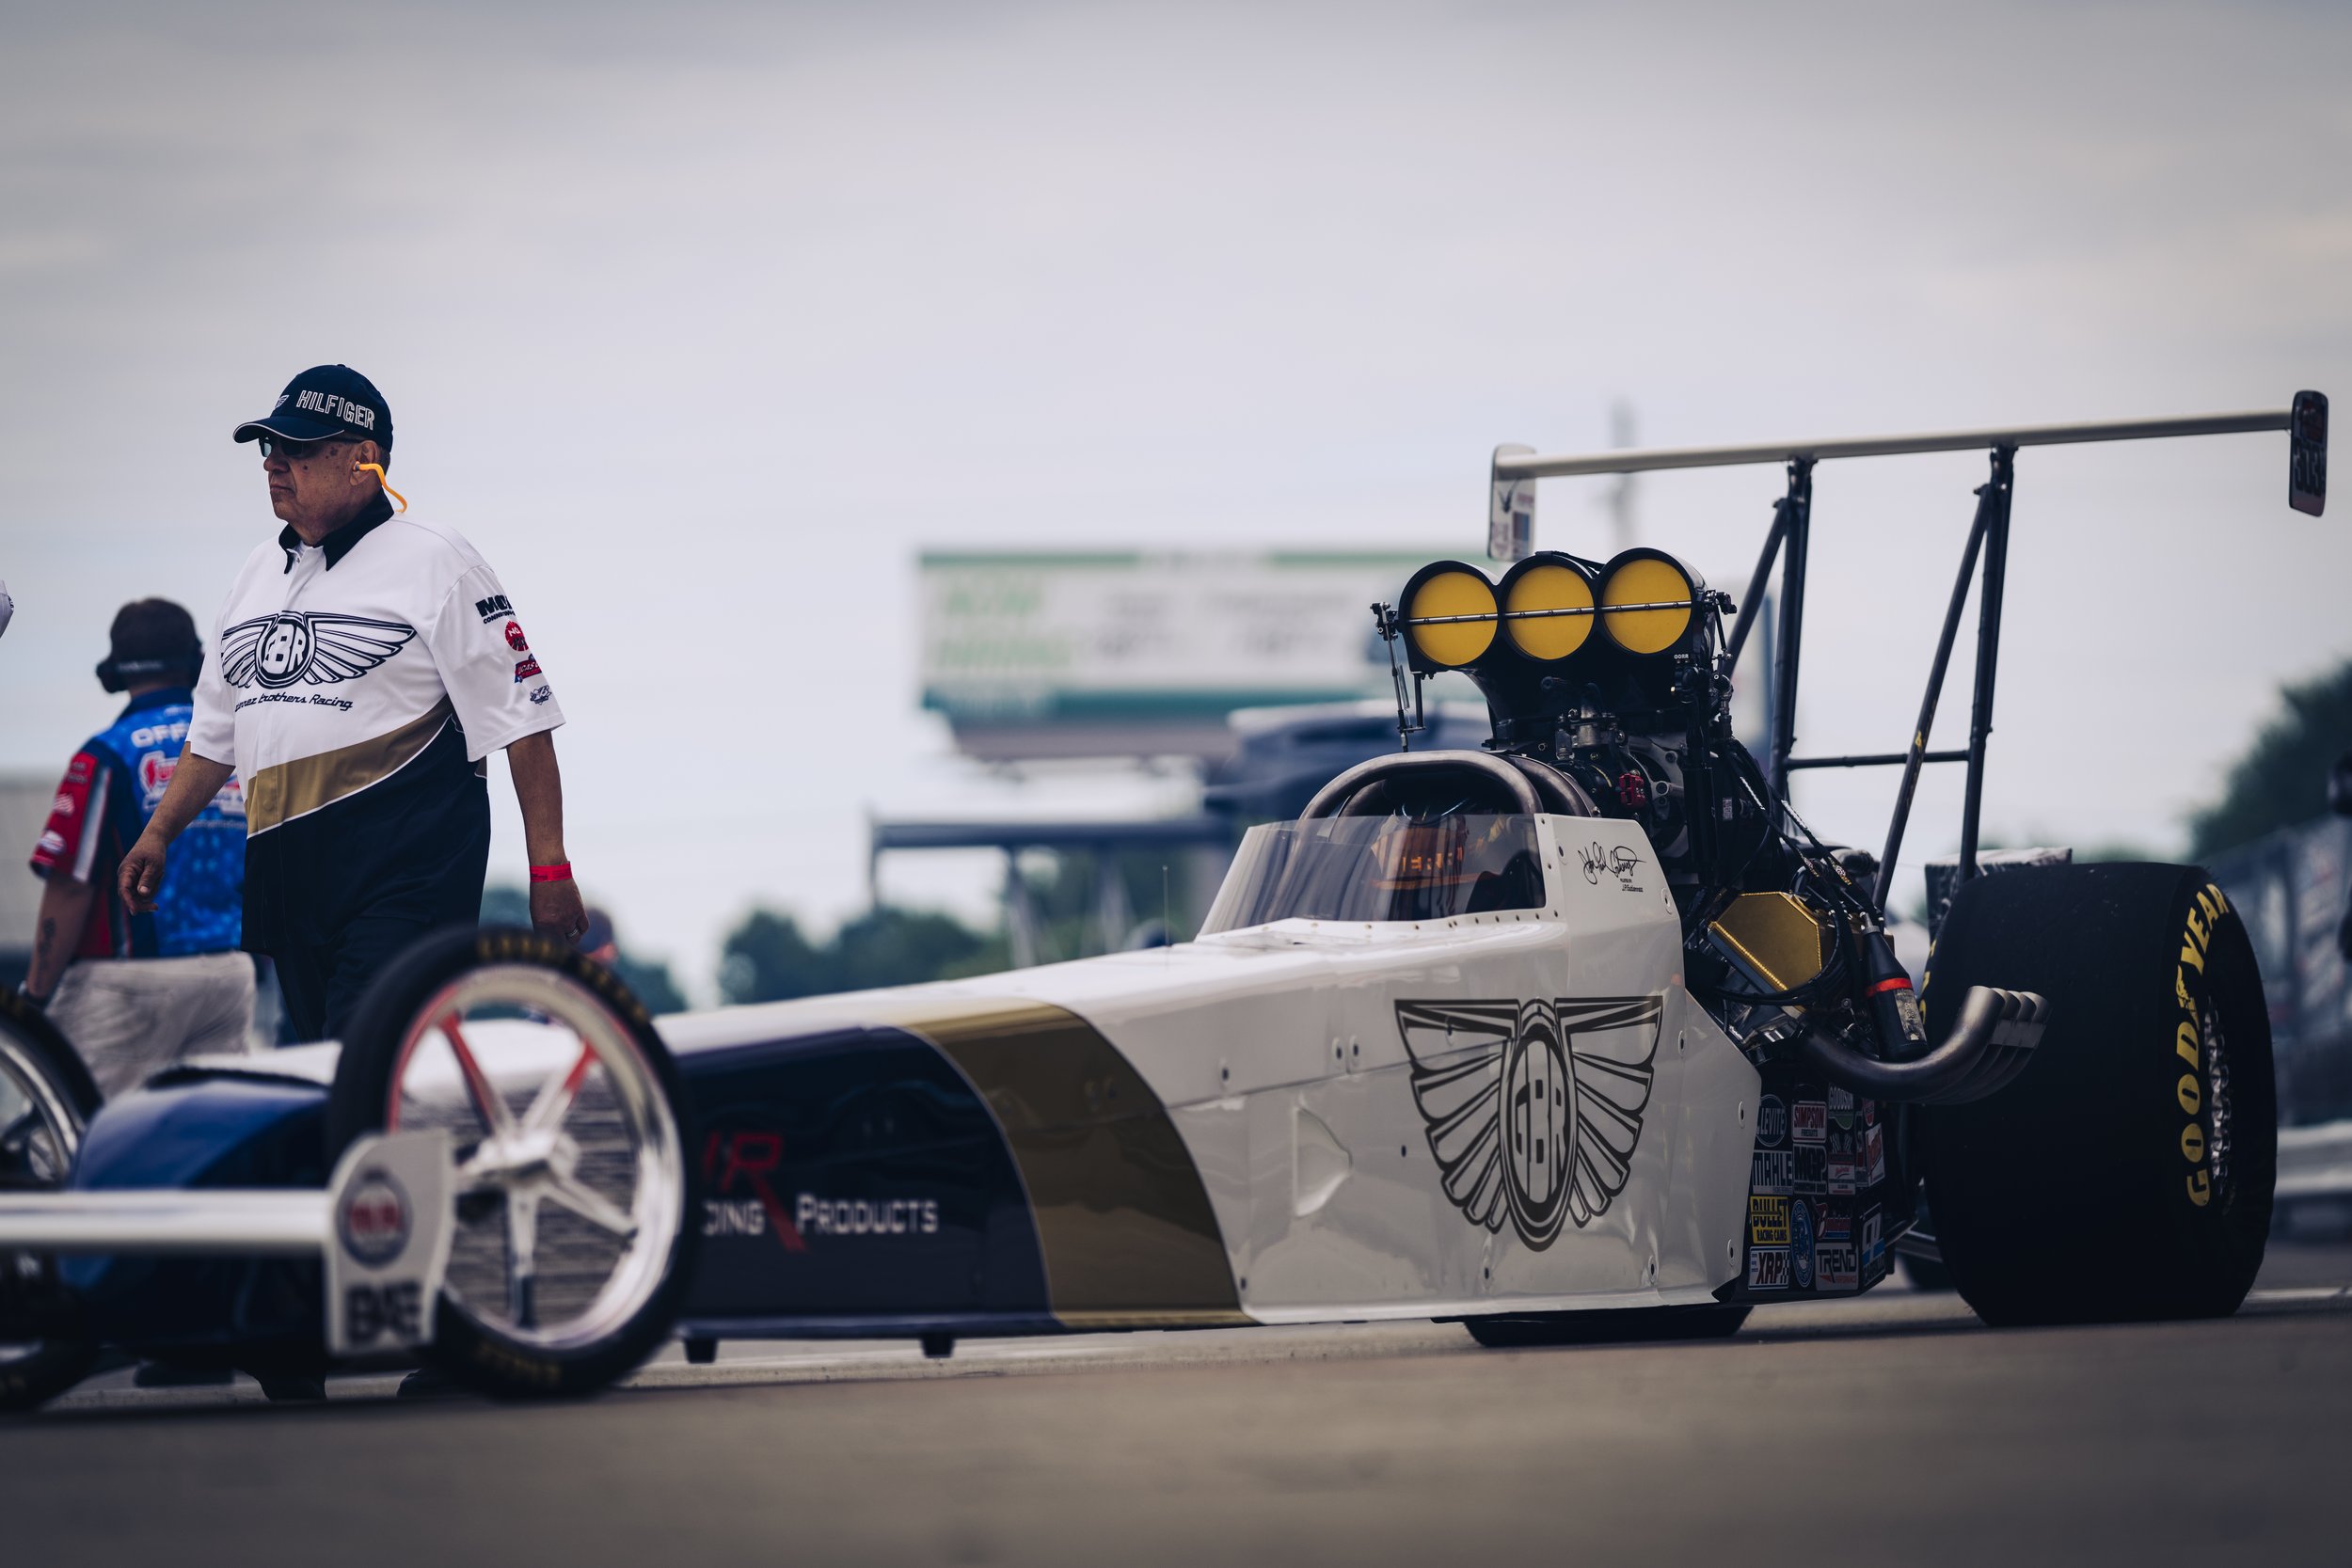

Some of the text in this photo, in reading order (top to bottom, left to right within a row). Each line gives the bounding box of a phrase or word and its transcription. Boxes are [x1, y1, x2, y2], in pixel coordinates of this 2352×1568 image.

[296, 389, 375, 431] HILFIGER
[310, 694, 354, 712] Racing
[132, 722, 190, 748] OFF
[1512, 1039, 1569, 1204] GBR
[1794, 1106, 1825, 1129] SIMPSON
[1753, 1150, 1793, 1187] MAHLE
[796, 1194, 938, 1234] PRODUCTS
[1753, 1198, 1788, 1227] BULLET
[1756, 1252, 1783, 1284] XRP
[1817, 1249, 1856, 1283] TREND
